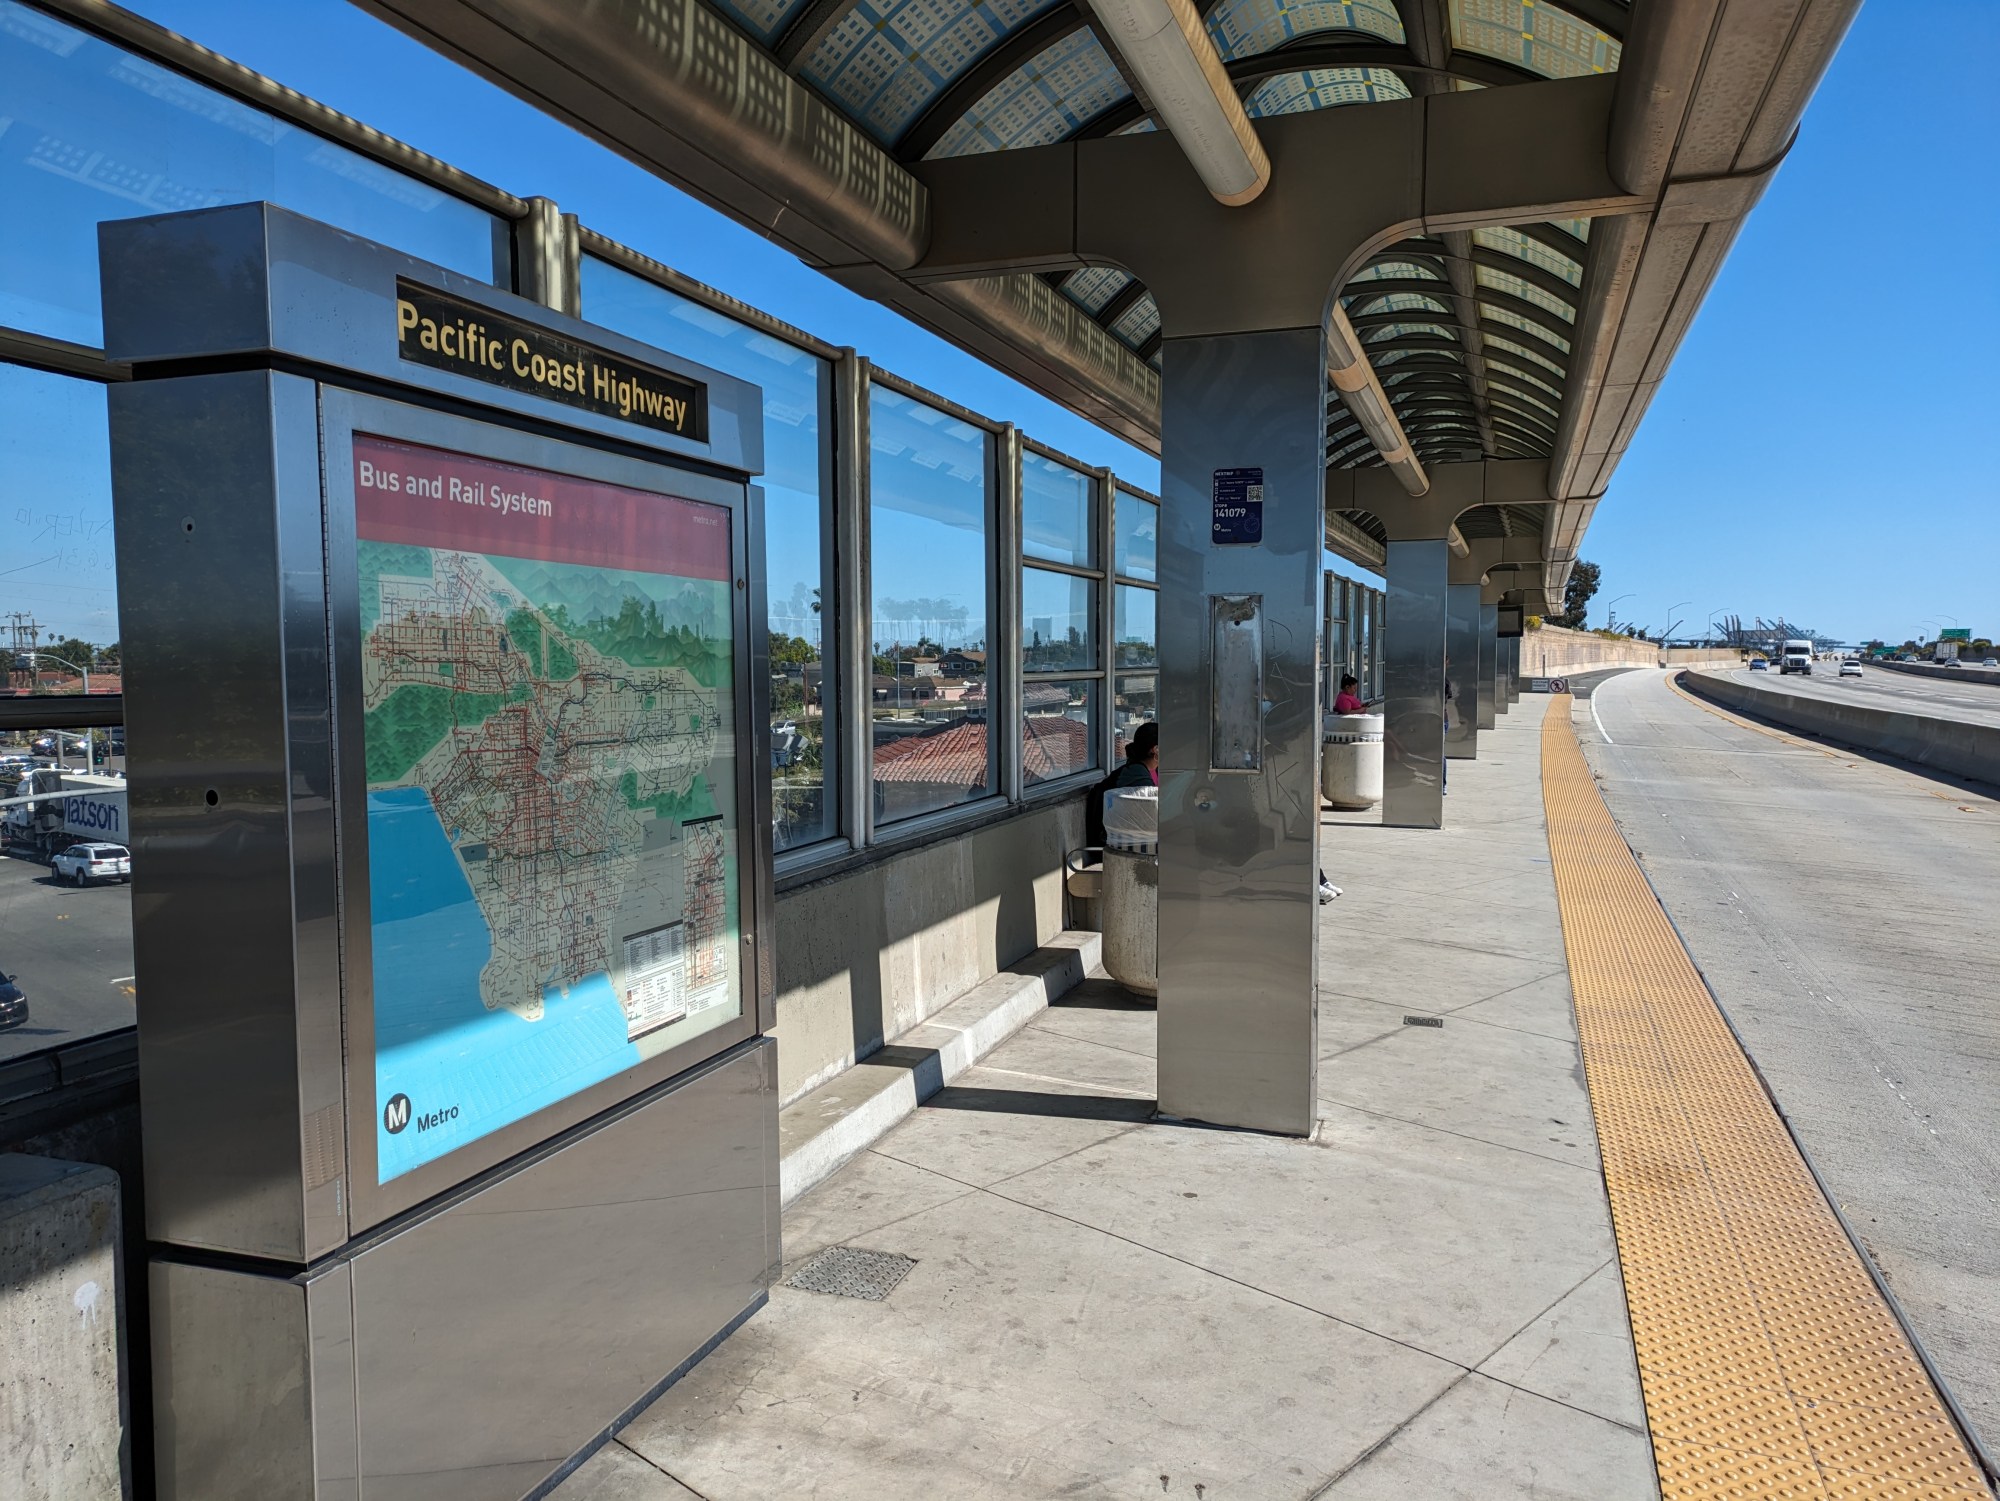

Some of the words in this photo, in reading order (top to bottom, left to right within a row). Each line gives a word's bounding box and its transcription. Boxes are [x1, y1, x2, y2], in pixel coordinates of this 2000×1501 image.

[397, 299, 503, 371] Pacific
[511, 338, 586, 396] Coast
[593, 364, 687, 432] Highway
[359, 460, 400, 492] Bus
[405, 475, 442, 499] and
[449, 477, 485, 506] Rail
[490, 484, 552, 517] System
[1214, 508, 1246, 518] 141079
[417, 1105, 459, 1133] Metro
